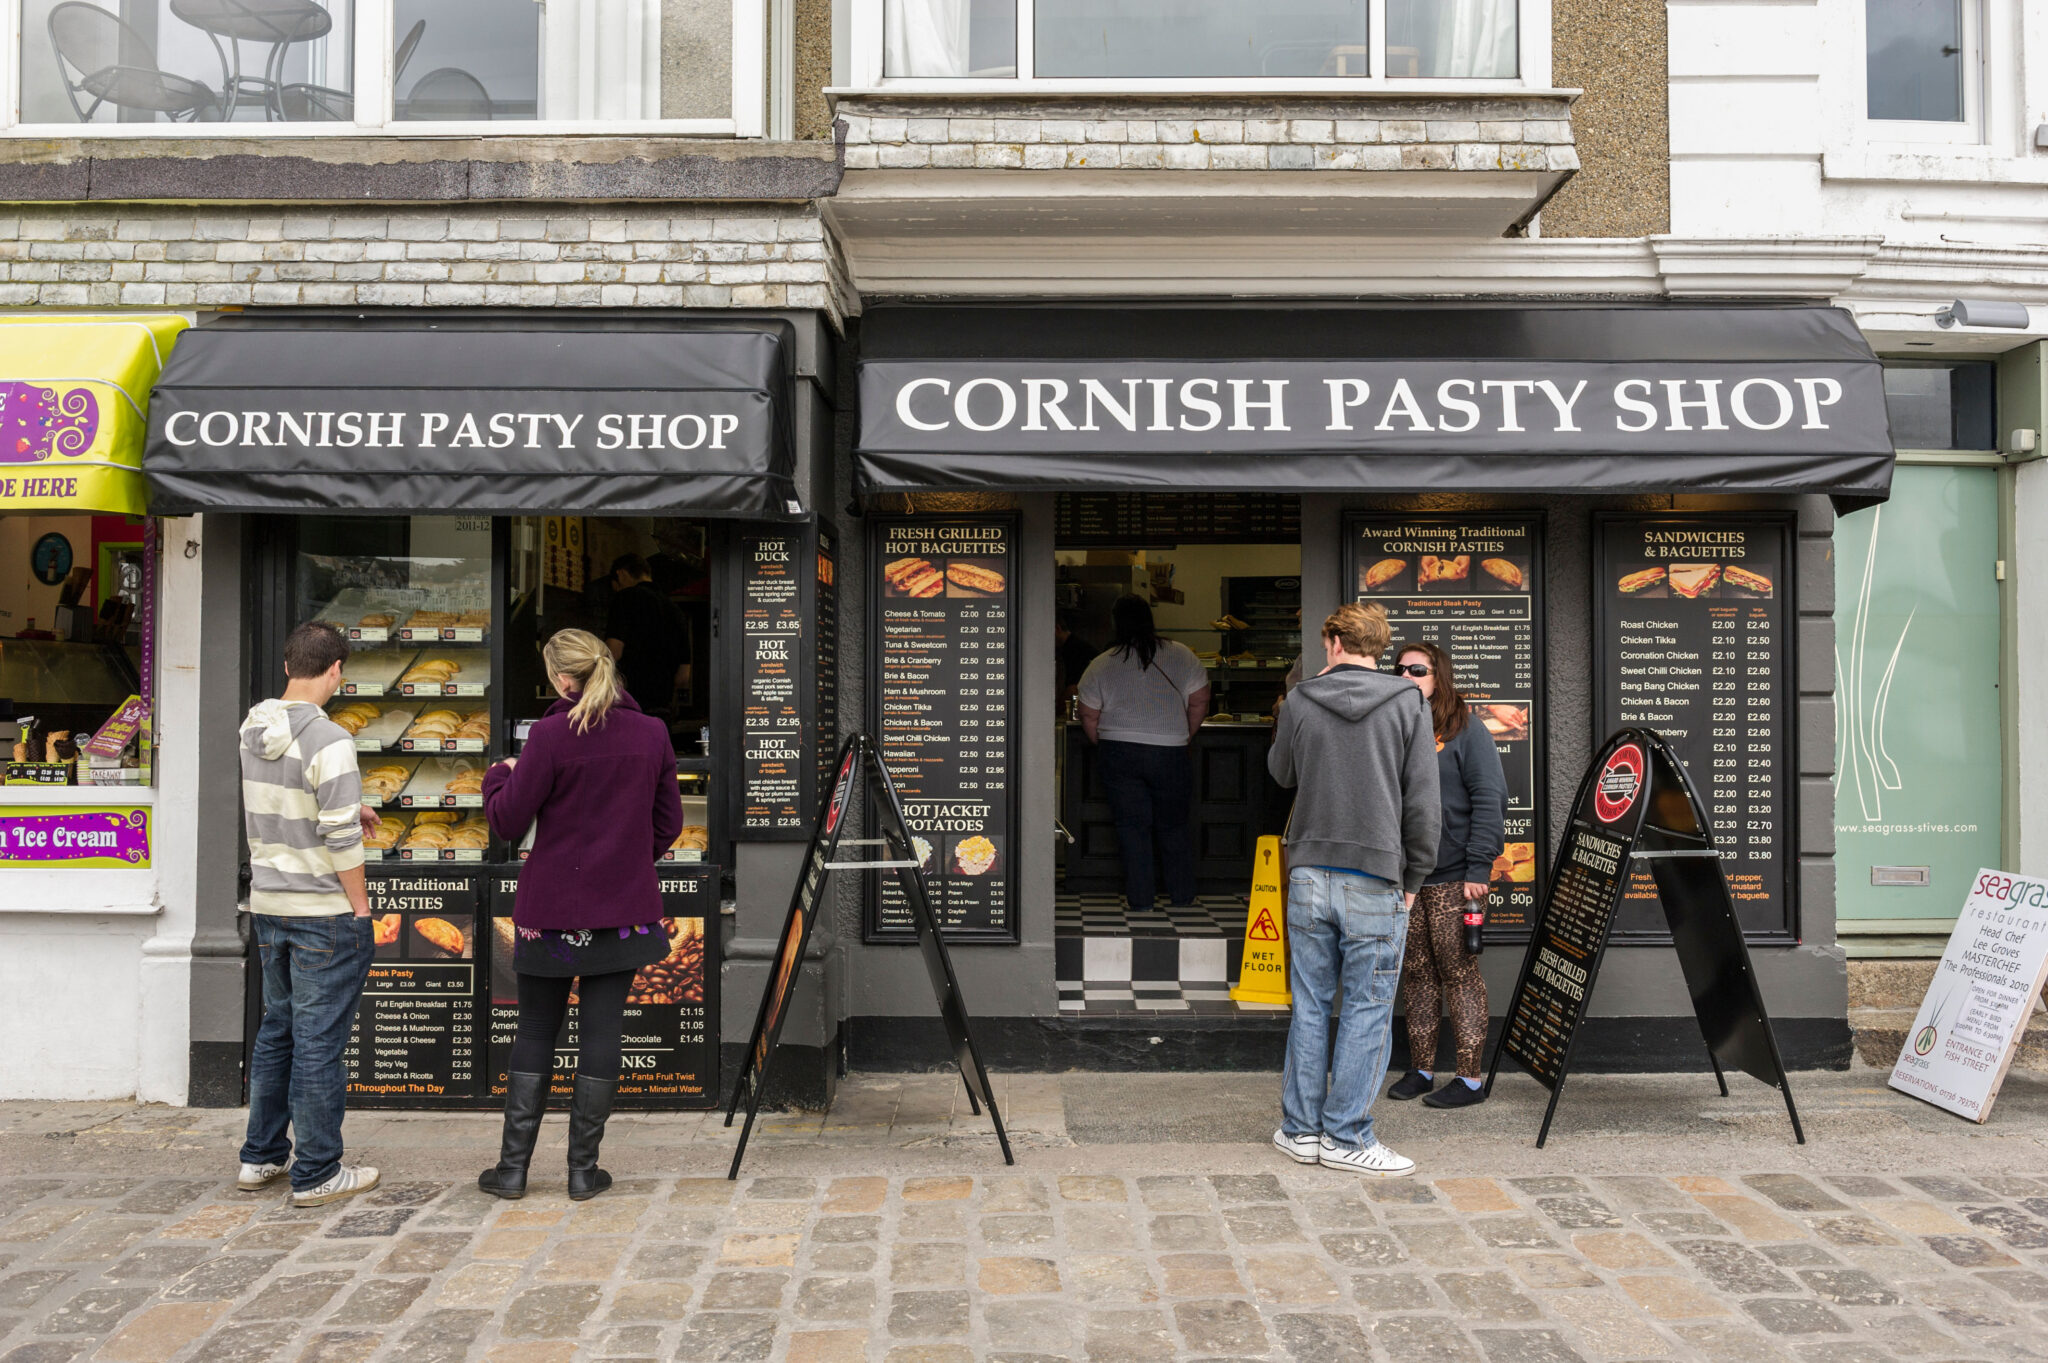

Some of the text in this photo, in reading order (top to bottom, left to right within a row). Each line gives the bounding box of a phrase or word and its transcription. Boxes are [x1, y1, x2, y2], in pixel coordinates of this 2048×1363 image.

[895, 376, 1843, 433] CORNISH PASTY SHOP
[164, 411, 739, 450] CORNISH PASTY SHOP
[21, 478, 77, 497] HERE
[456, 521, 489, 530] 2011-12
[890, 528, 1001, 539] FRESH GRILLED
[1362, 526, 1525, 540] Award Winning Traditional
[1645, 532, 1744, 543] SANDWICHES
[759, 542, 785, 551] HOT
[885, 543, 1006, 554] HOT BAGUETTES
[1384, 542, 1504, 552] CORNISH PASTIES
[1645, 547, 1745, 557] & BAGUETTES
[755, 552, 789, 561] DUCK
[1621, 621, 1644, 629] Roast
[1646, 621, 1678, 629] Chicken
[1712, 621, 1735, 629] £2.00
[759, 640, 785, 649] HOT
[1747, 637, 1769, 645] £2.50
[756, 651, 789, 659] PORK
[1621, 652, 1770, 660] Coronation Chicken £2.10 £2.50
[1621, 683, 1642, 692] Bang
[1644, 683, 1665, 692] Bang
[1747, 683, 1770, 691] £2.60
[746, 718, 800, 726] £2.35 £2.95
[759, 740, 786, 748] HOT
[745, 750, 800, 759] CHICKEN
[900, 805, 990, 819] HOT JACKET
[746, 818, 800, 826] £2.35 £2.95
[906, 820, 984, 831] POTATOES
[1835, 823, 1977, 835] ww.seagrass-stives.com
[12, 827, 47, 847] Ice
[52, 827, 117, 847] Cream
[1577, 832, 1622, 859] SANDWICHES
[1578, 849, 1617, 875] BAGUETTES
[1736, 874, 1763, 883] pepper,
[390, 879, 469, 891] Traditional
[1255, 884, 1277, 892] CAUTION
[1510, 894, 1533, 907] 90p
[1738, 892, 1769, 900] baguette
[378, 897, 443, 909] PASTIES
[1970, 907, 2046, 933] restaurant
[1980, 925, 2026, 944] Head Chef
[1973, 938, 2020, 958] Lee Groves
[1252, 952, 1275, 960] WET
[1962, 950, 2021, 973] MASTERCHEF
[1244, 962, 1281, 973] FLOOR
[1539, 947, 1587, 984] FRESH GRILLED
[391, 970, 414, 979] Pasty
[1944, 960, 2029, 992] The Professionals 2010
[376, 981, 393, 989] Large
[1533, 961, 1584, 1002] HOT BAGUETTES
[1972, 986, 1985, 994] OPEN
[1998, 994, 2018, 1004] DINNER
[389, 1001, 413, 1010] English
[680, 1008, 704, 1016] £1.15
[680, 1022, 704, 1030] £1.05
[621, 1035, 704, 1043] Chocolate £1.45
[1946, 1039, 1998, 1063] ENTRANCE ON
[1903, 1054, 1930, 1069] seagrass
[1945, 1051, 1989, 1072] FISH STREET
[632, 1073, 695, 1081] Fanta Fruit Twist
[1895, 1070, 1938, 1093] RESERVATIONS
[355, 1085, 406, 1094] Throughout
[427, 1085, 444, 1094] Day
[650, 1085, 703, 1093] Mineral Water
